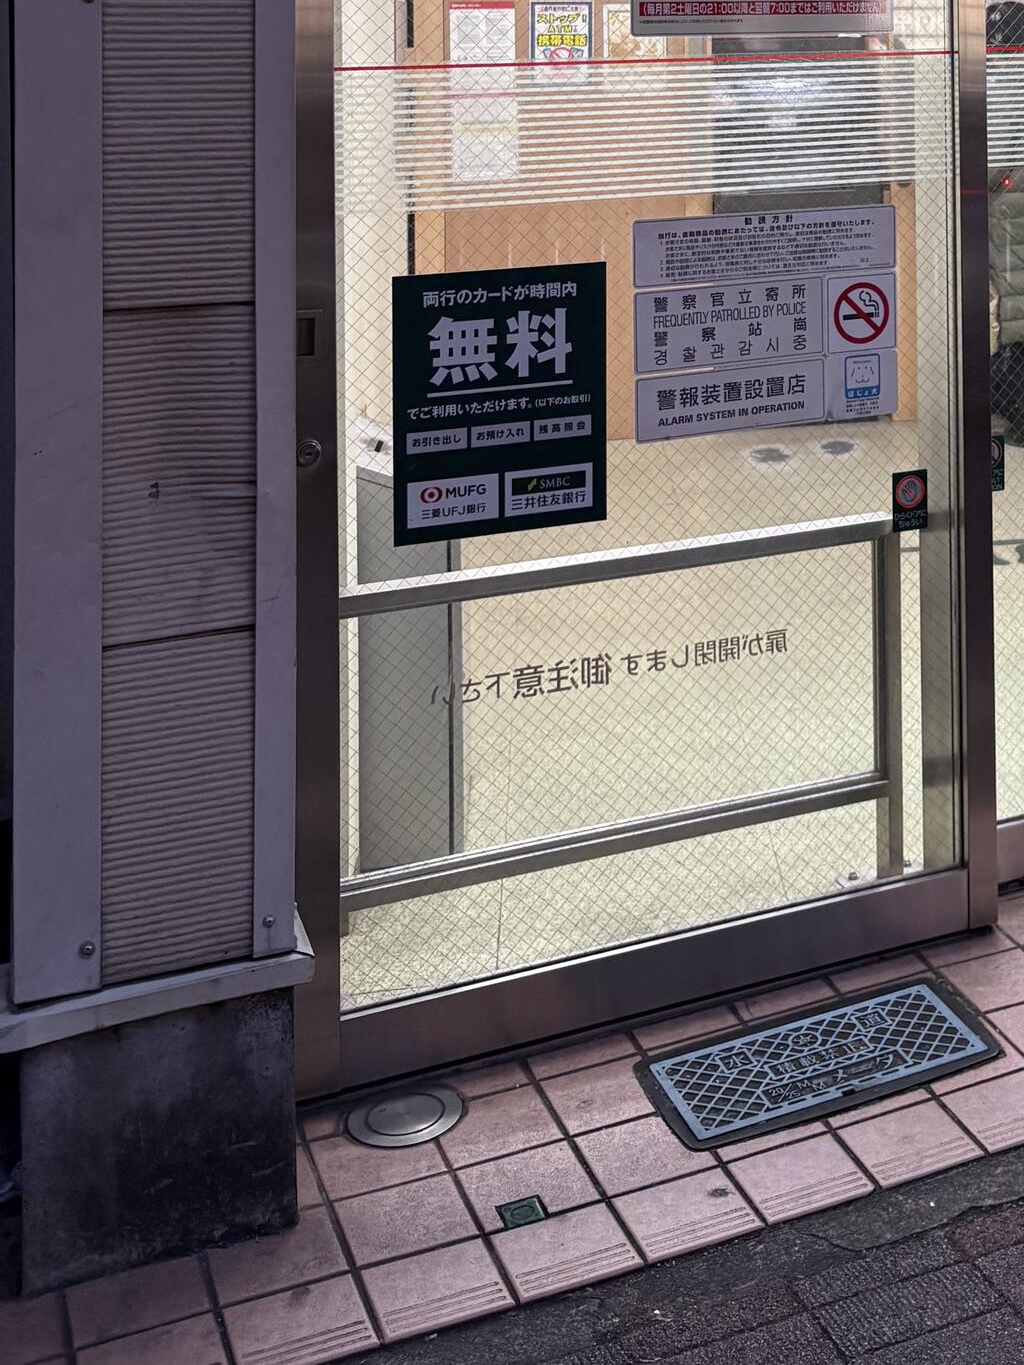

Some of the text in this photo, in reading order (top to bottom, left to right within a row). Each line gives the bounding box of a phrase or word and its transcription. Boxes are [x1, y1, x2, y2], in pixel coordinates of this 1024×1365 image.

[423, 282, 577, 308] 両行のカードが時間内
[653, 284, 807, 313] 警察官立寄所
[653, 301, 807, 330] FREQUENTLY PATROLLED BY POLICE
[653, 317, 807, 348] 警察站崗
[427, 307, 573, 386] 無料
[653, 335, 808, 366] 경찰관감시중
[656, 374, 807, 412] 警報装置設置店
[407, 397, 533, 421] でご利用いただけます。
[657, 400, 805, 428] ALARM SYSTEM IN OPERATION
[412, 420, 587, 448] お引き出し お預け入れ 残高照会
[445, 484, 487, 499] MUFG
[539, 476, 571, 490] SMBC
[421, 503, 487, 520] 三菱UFJ銀行
[511, 491, 586, 511] 三井住友銀行
[861, 1011, 885, 1028] 道
[724, 1052, 752, 1069] 水
